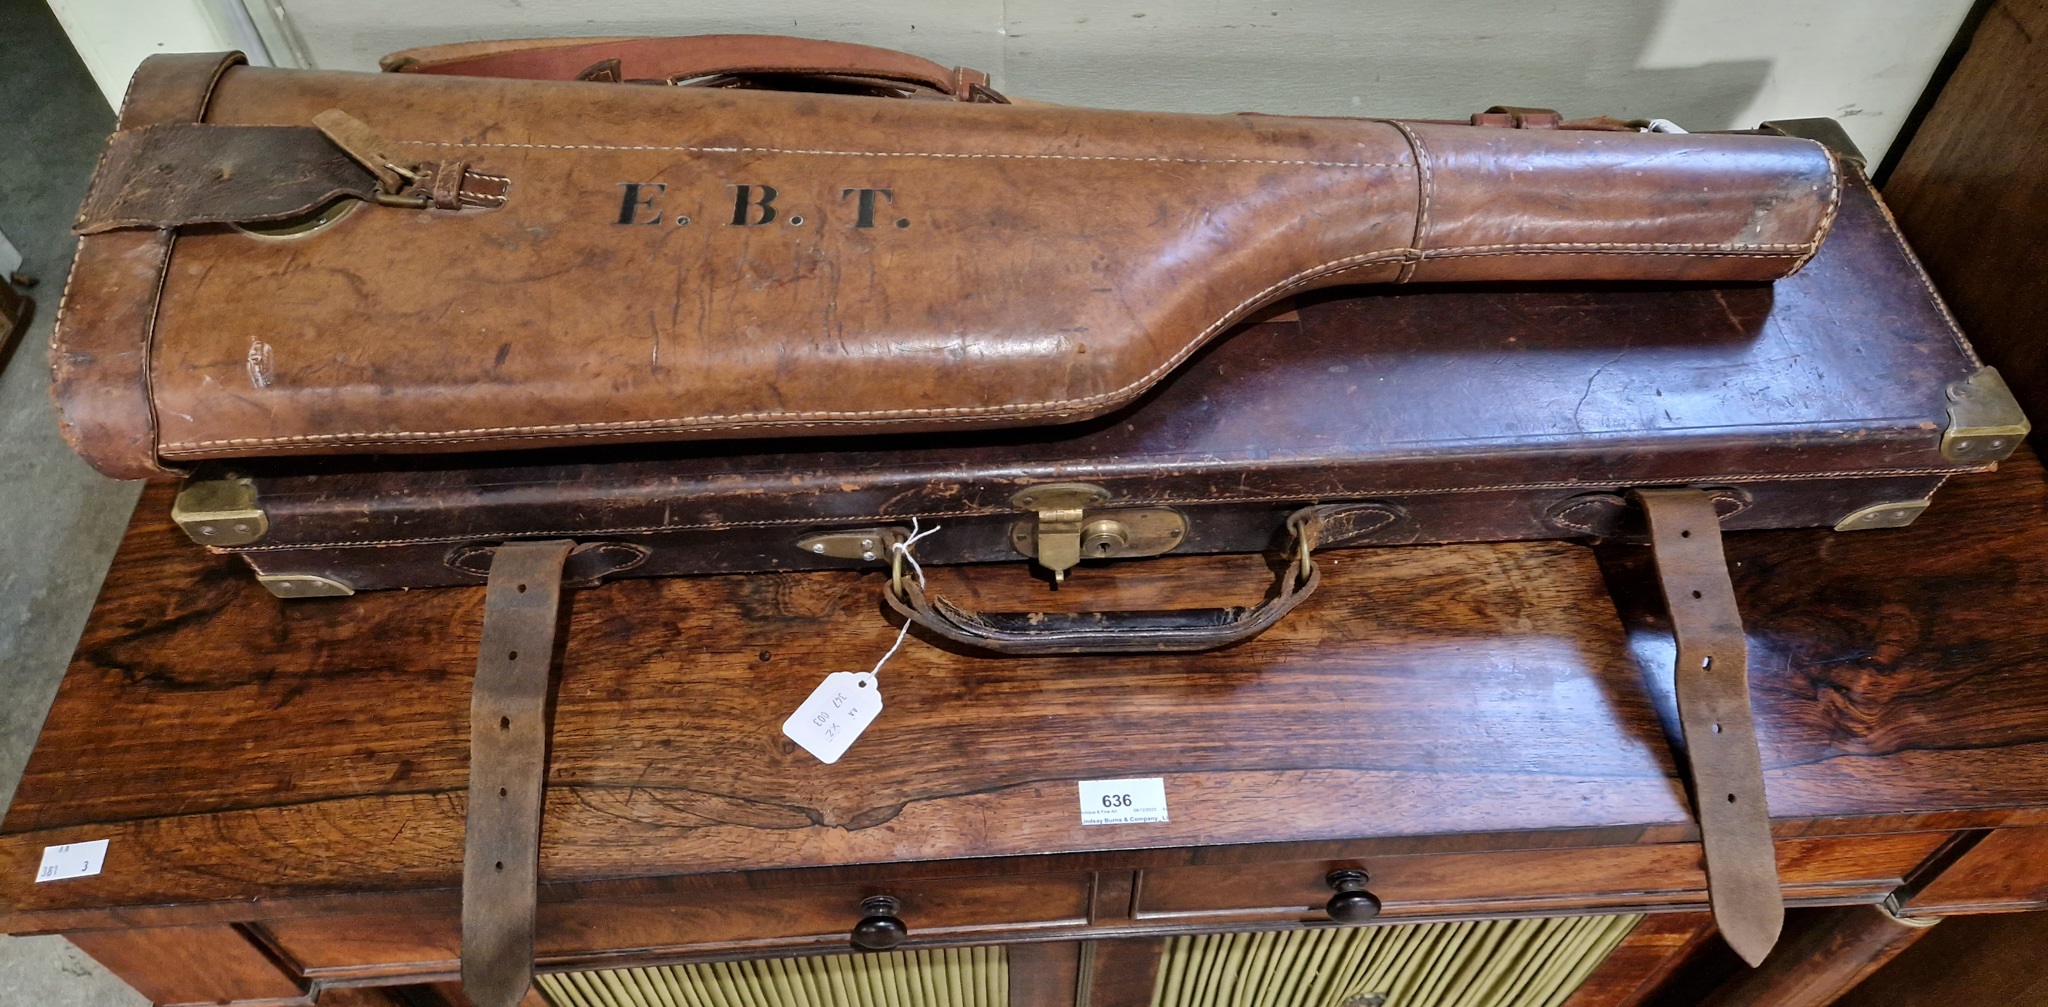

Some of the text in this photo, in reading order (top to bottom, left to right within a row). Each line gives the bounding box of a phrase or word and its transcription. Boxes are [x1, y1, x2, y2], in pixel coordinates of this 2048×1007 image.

[609, 182, 911, 229] E. B. T.
[812, 692, 847, 727] 347 003
[1102, 794, 1132, 808] 636
[41, 860, 89, 877] 381 3
